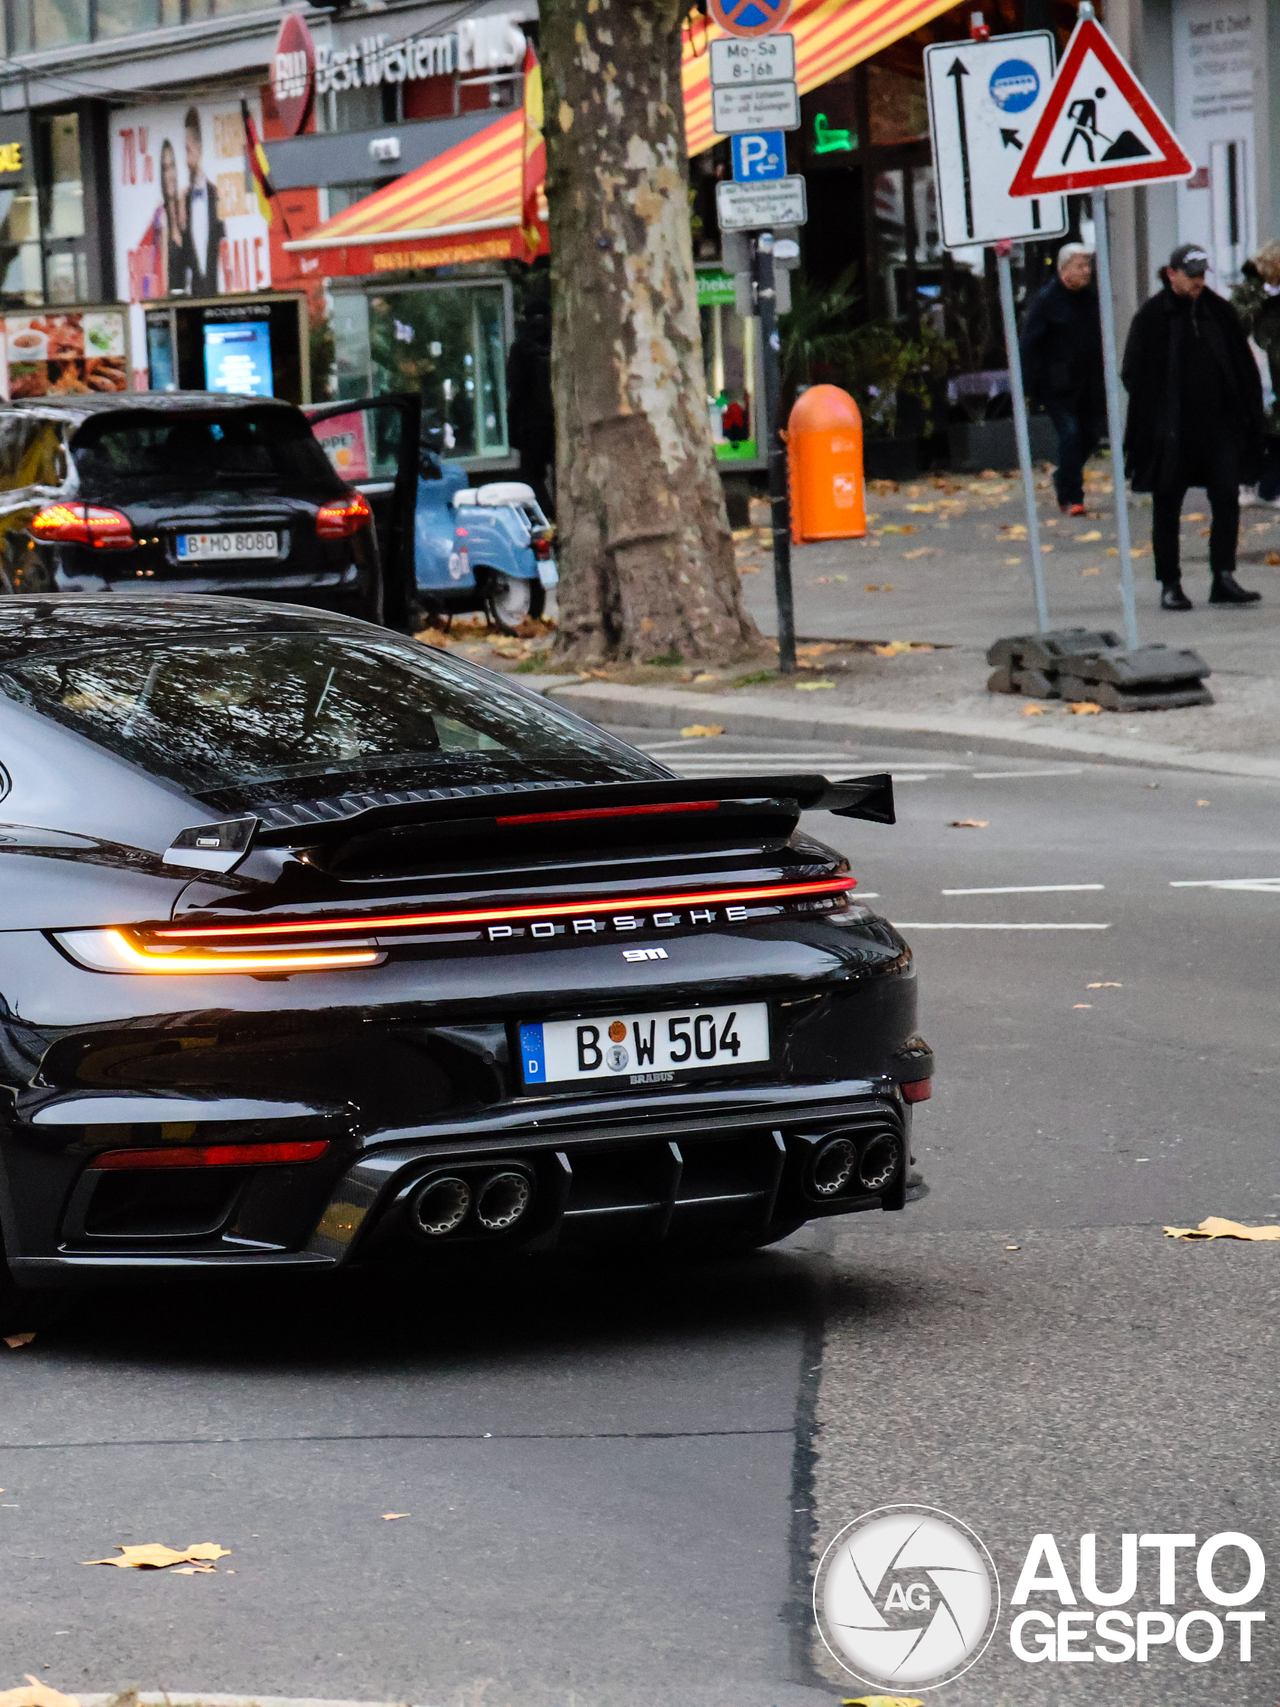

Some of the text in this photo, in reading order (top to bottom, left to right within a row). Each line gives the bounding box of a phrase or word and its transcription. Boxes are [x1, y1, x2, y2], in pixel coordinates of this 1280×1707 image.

[727, 42, 777, 58] Mo-Sa
[740, 136, 768, 176] P
[188, 533, 275, 553] B MO 8080
[488, 905, 749, 941] PORSCHE
[622, 947, 669, 963] 911
[576, 1012, 741, 1072] B W 504
[528, 1059, 539, 1074] D
[630, 1071, 675, 1085] BRABUS
